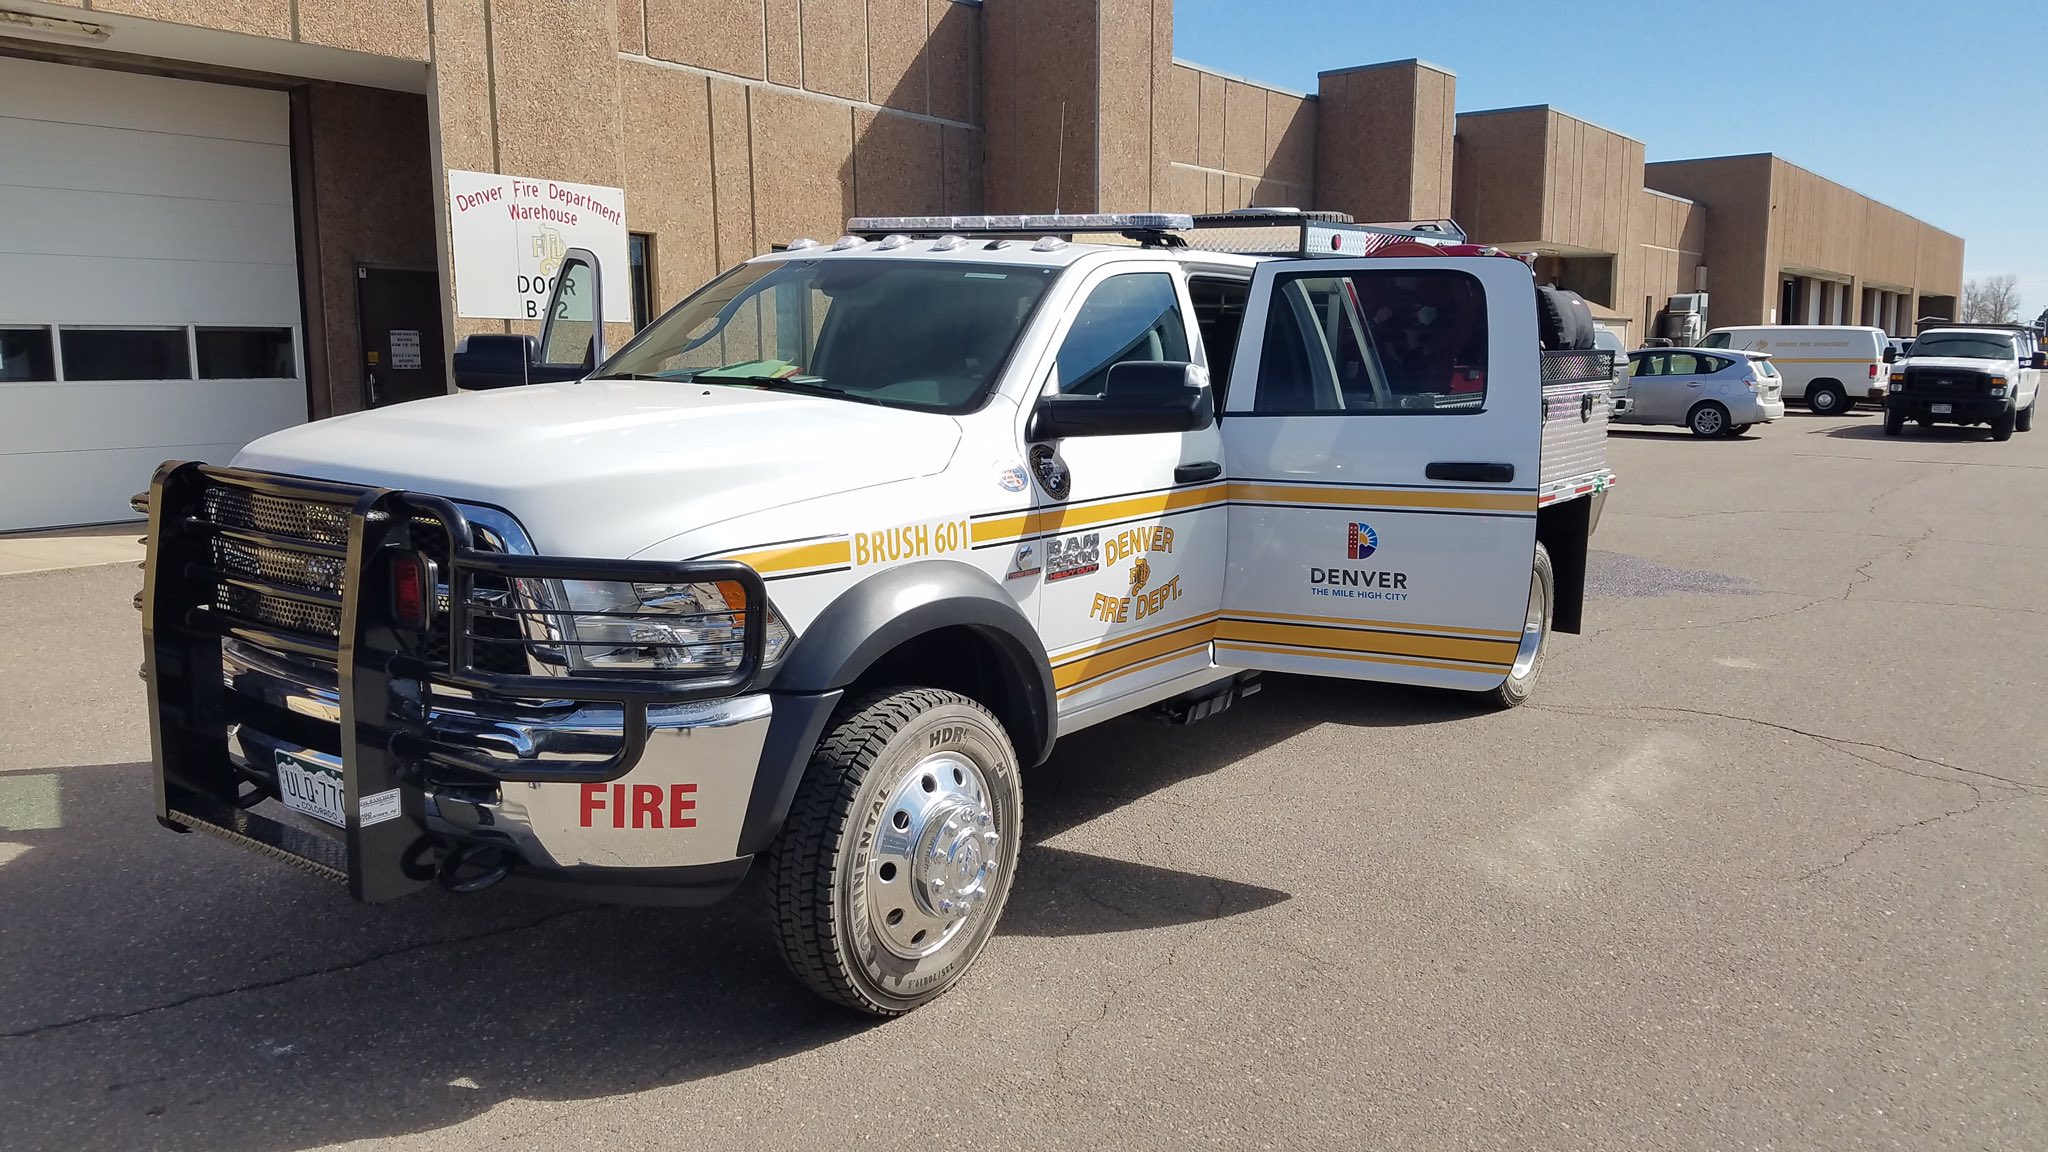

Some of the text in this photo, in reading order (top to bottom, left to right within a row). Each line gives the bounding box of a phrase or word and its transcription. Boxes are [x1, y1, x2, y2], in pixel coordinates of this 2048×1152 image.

[456, 180, 622, 226] Denver Fire Department
[507, 204, 578, 226] Warehouse
[855, 520, 968, 566] BRUSH 601
[1046, 533, 1100, 556] RAM
[1105, 526, 1175, 568] DENVER
[1046, 548, 1100, 571] 5500
[1049, 564, 1098, 580] HEAVY DUTY
[1310, 567, 1407, 590] DENVER
[1089, 574, 1182, 624] FIRE DEPT.
[1311, 587, 1408, 601] THE MILE HIGH CITY
[301, 801, 338, 821] COLORADO
[580, 783, 698, 829] FIRE
[853, 787, 890, 967] CONTINENTAL
